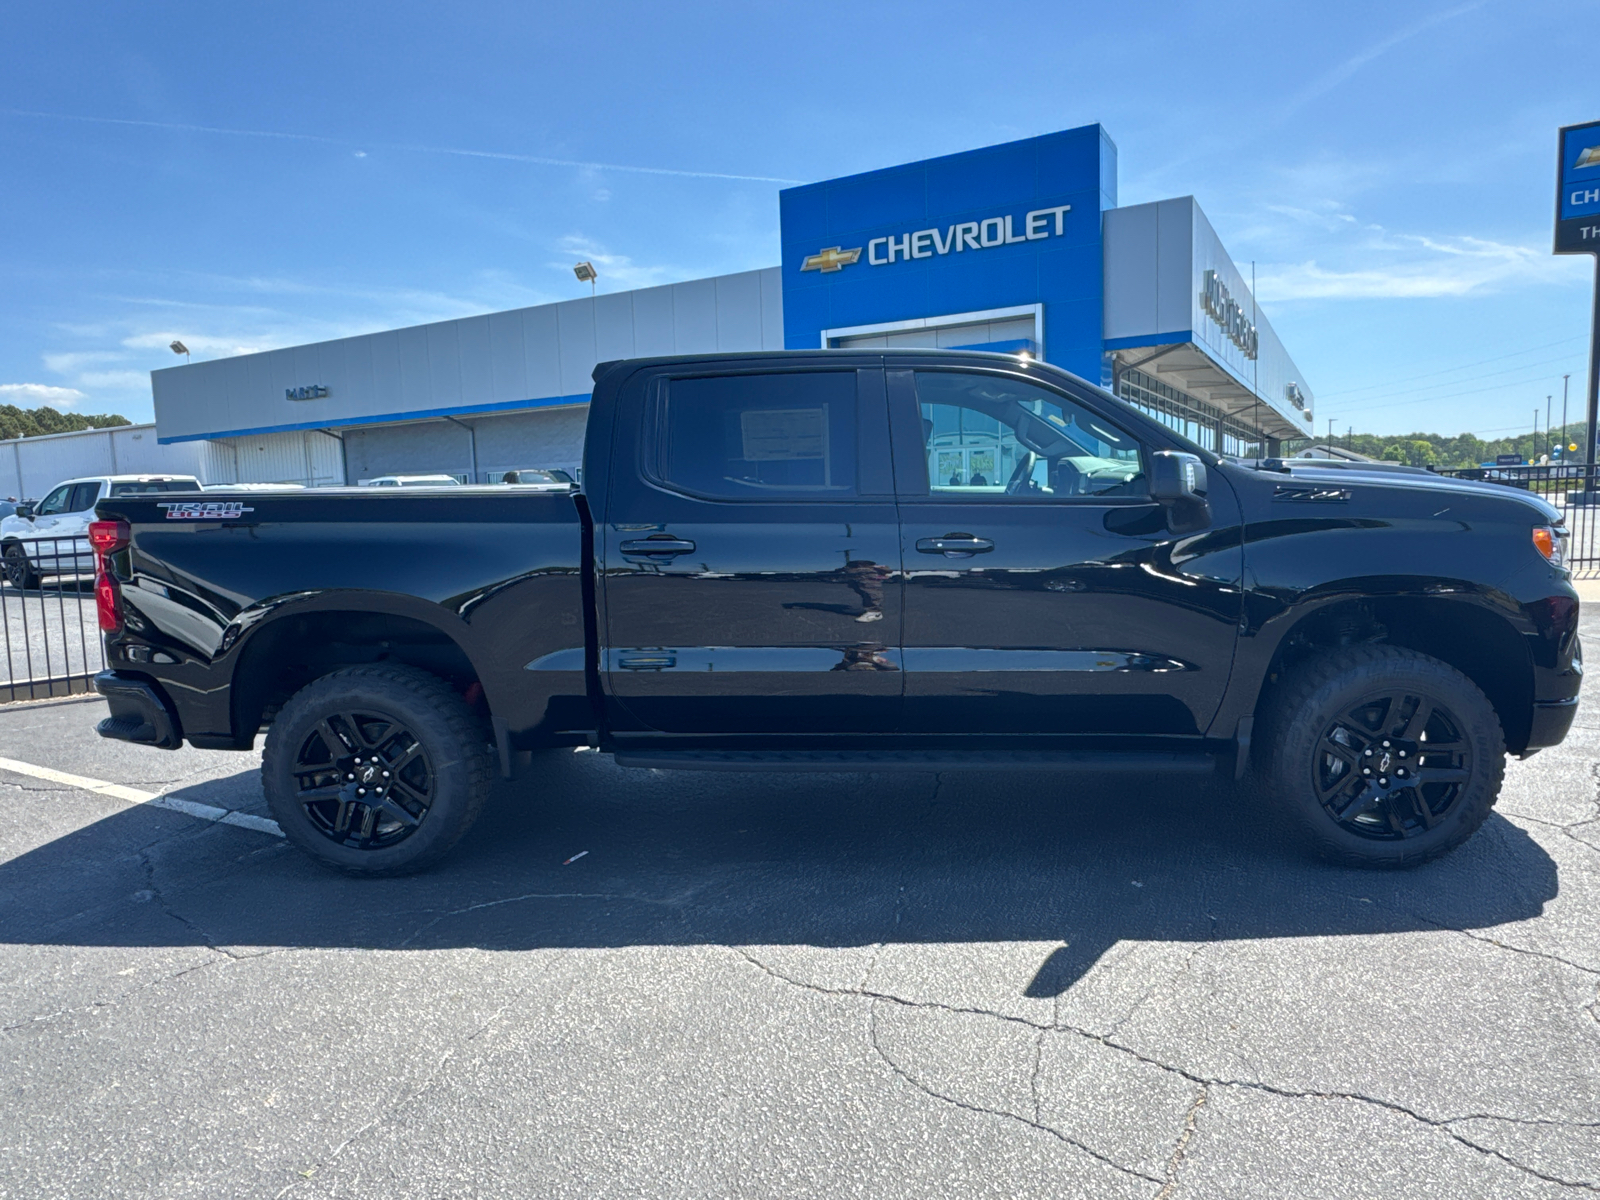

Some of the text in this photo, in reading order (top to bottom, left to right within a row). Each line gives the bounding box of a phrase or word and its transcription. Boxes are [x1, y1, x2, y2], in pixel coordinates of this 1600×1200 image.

[868, 204, 1071, 266] CHEVROLET
[157, 502, 254, 512] TRAIL
[166, 511, 241, 519] BOSS
